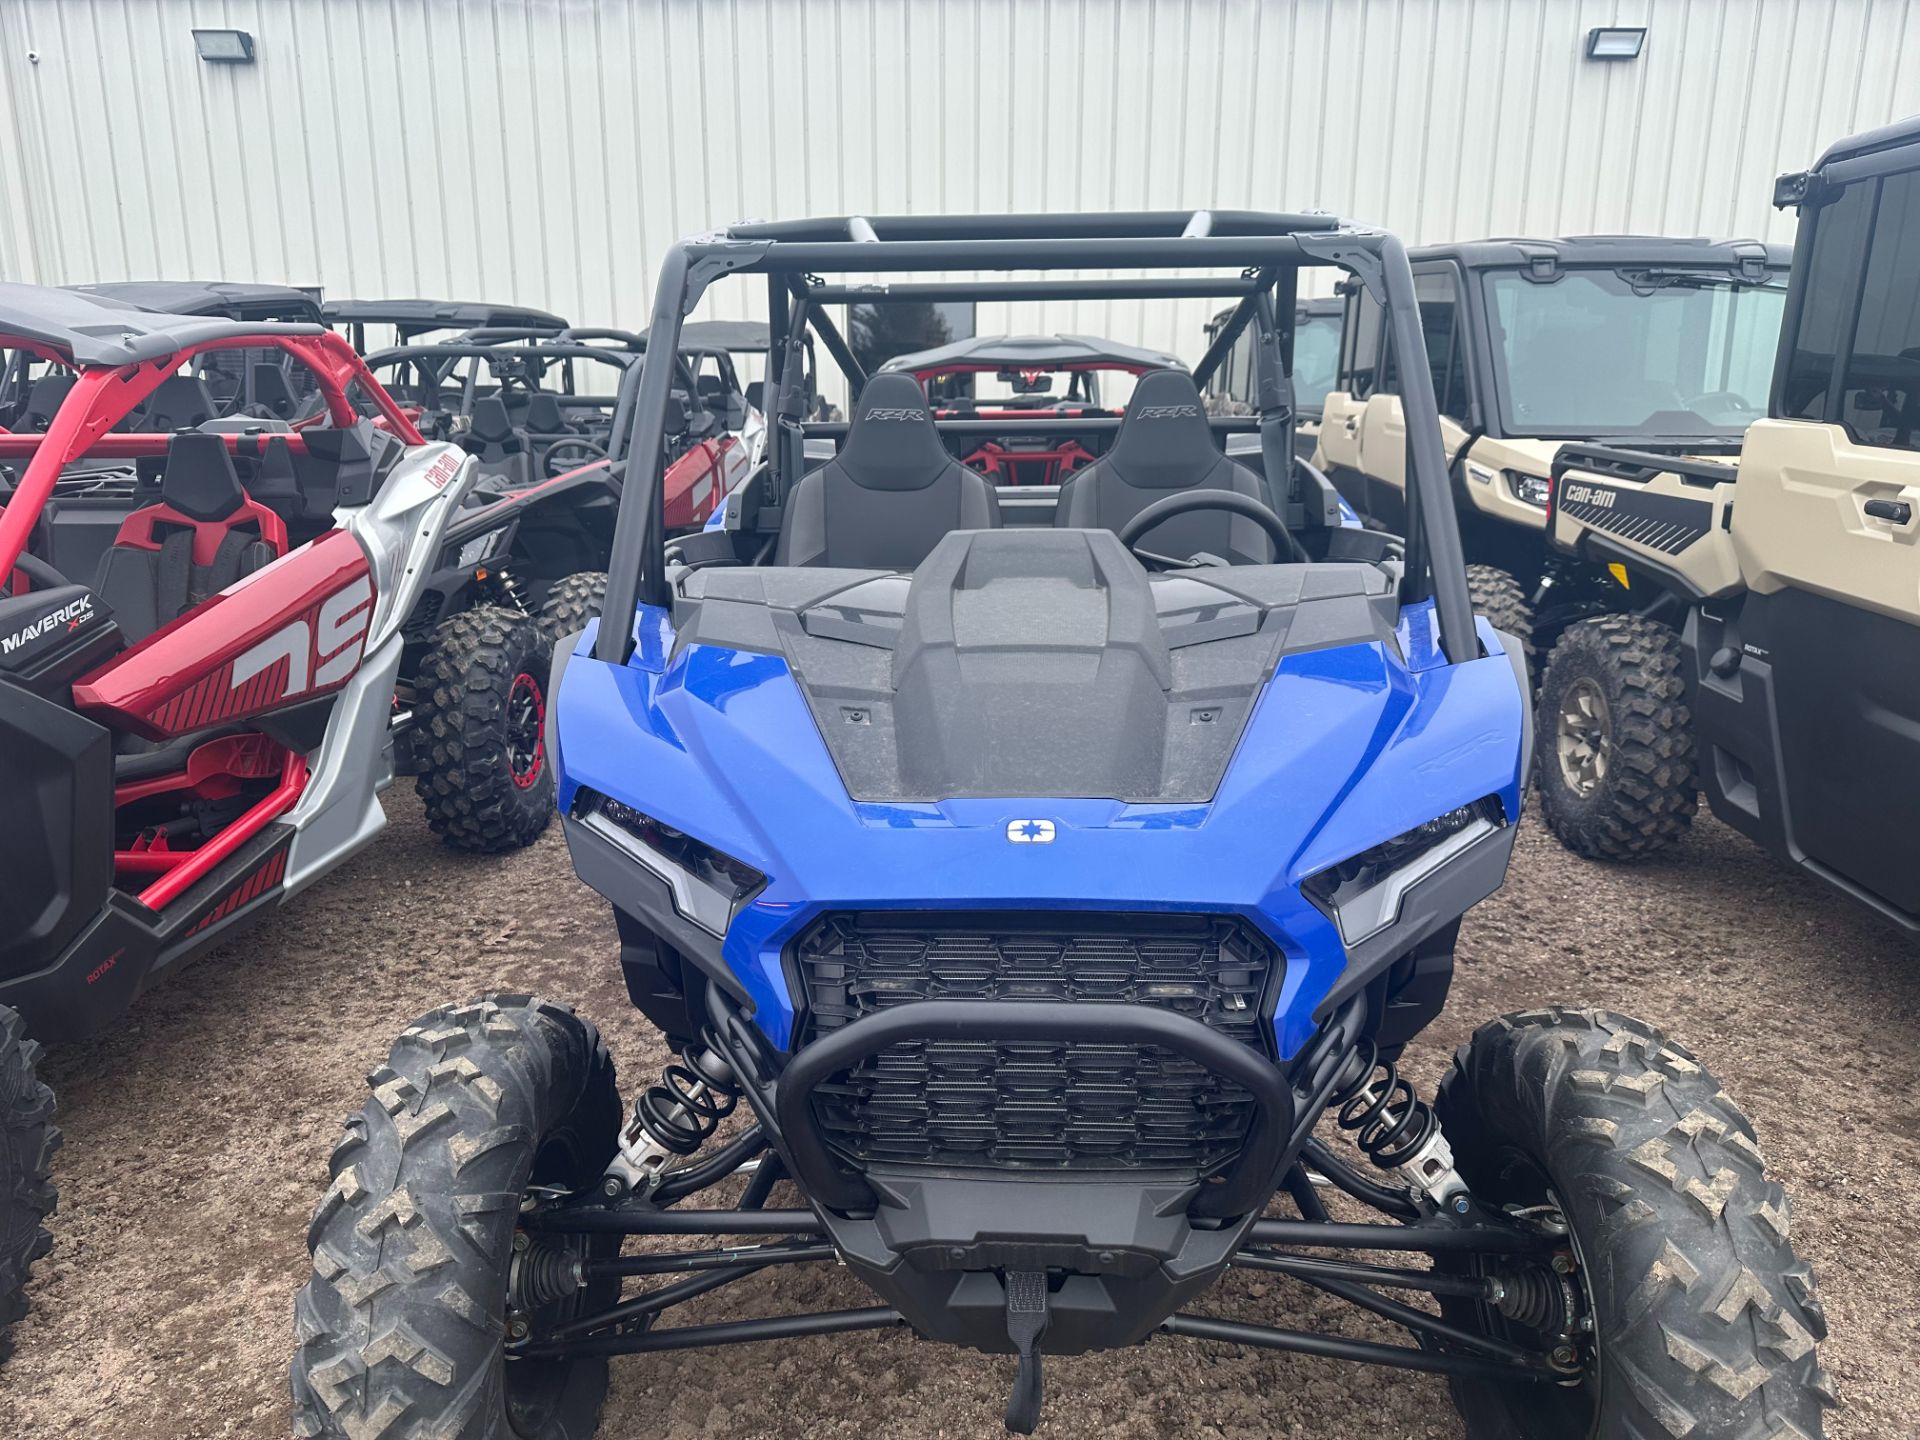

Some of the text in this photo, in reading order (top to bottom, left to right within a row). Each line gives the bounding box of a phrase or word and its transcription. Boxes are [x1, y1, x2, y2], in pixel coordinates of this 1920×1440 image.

[424, 453, 460, 489] can-am
[1566, 485, 1616, 508] can-am
[0, 594, 93, 655] MAVERICK
